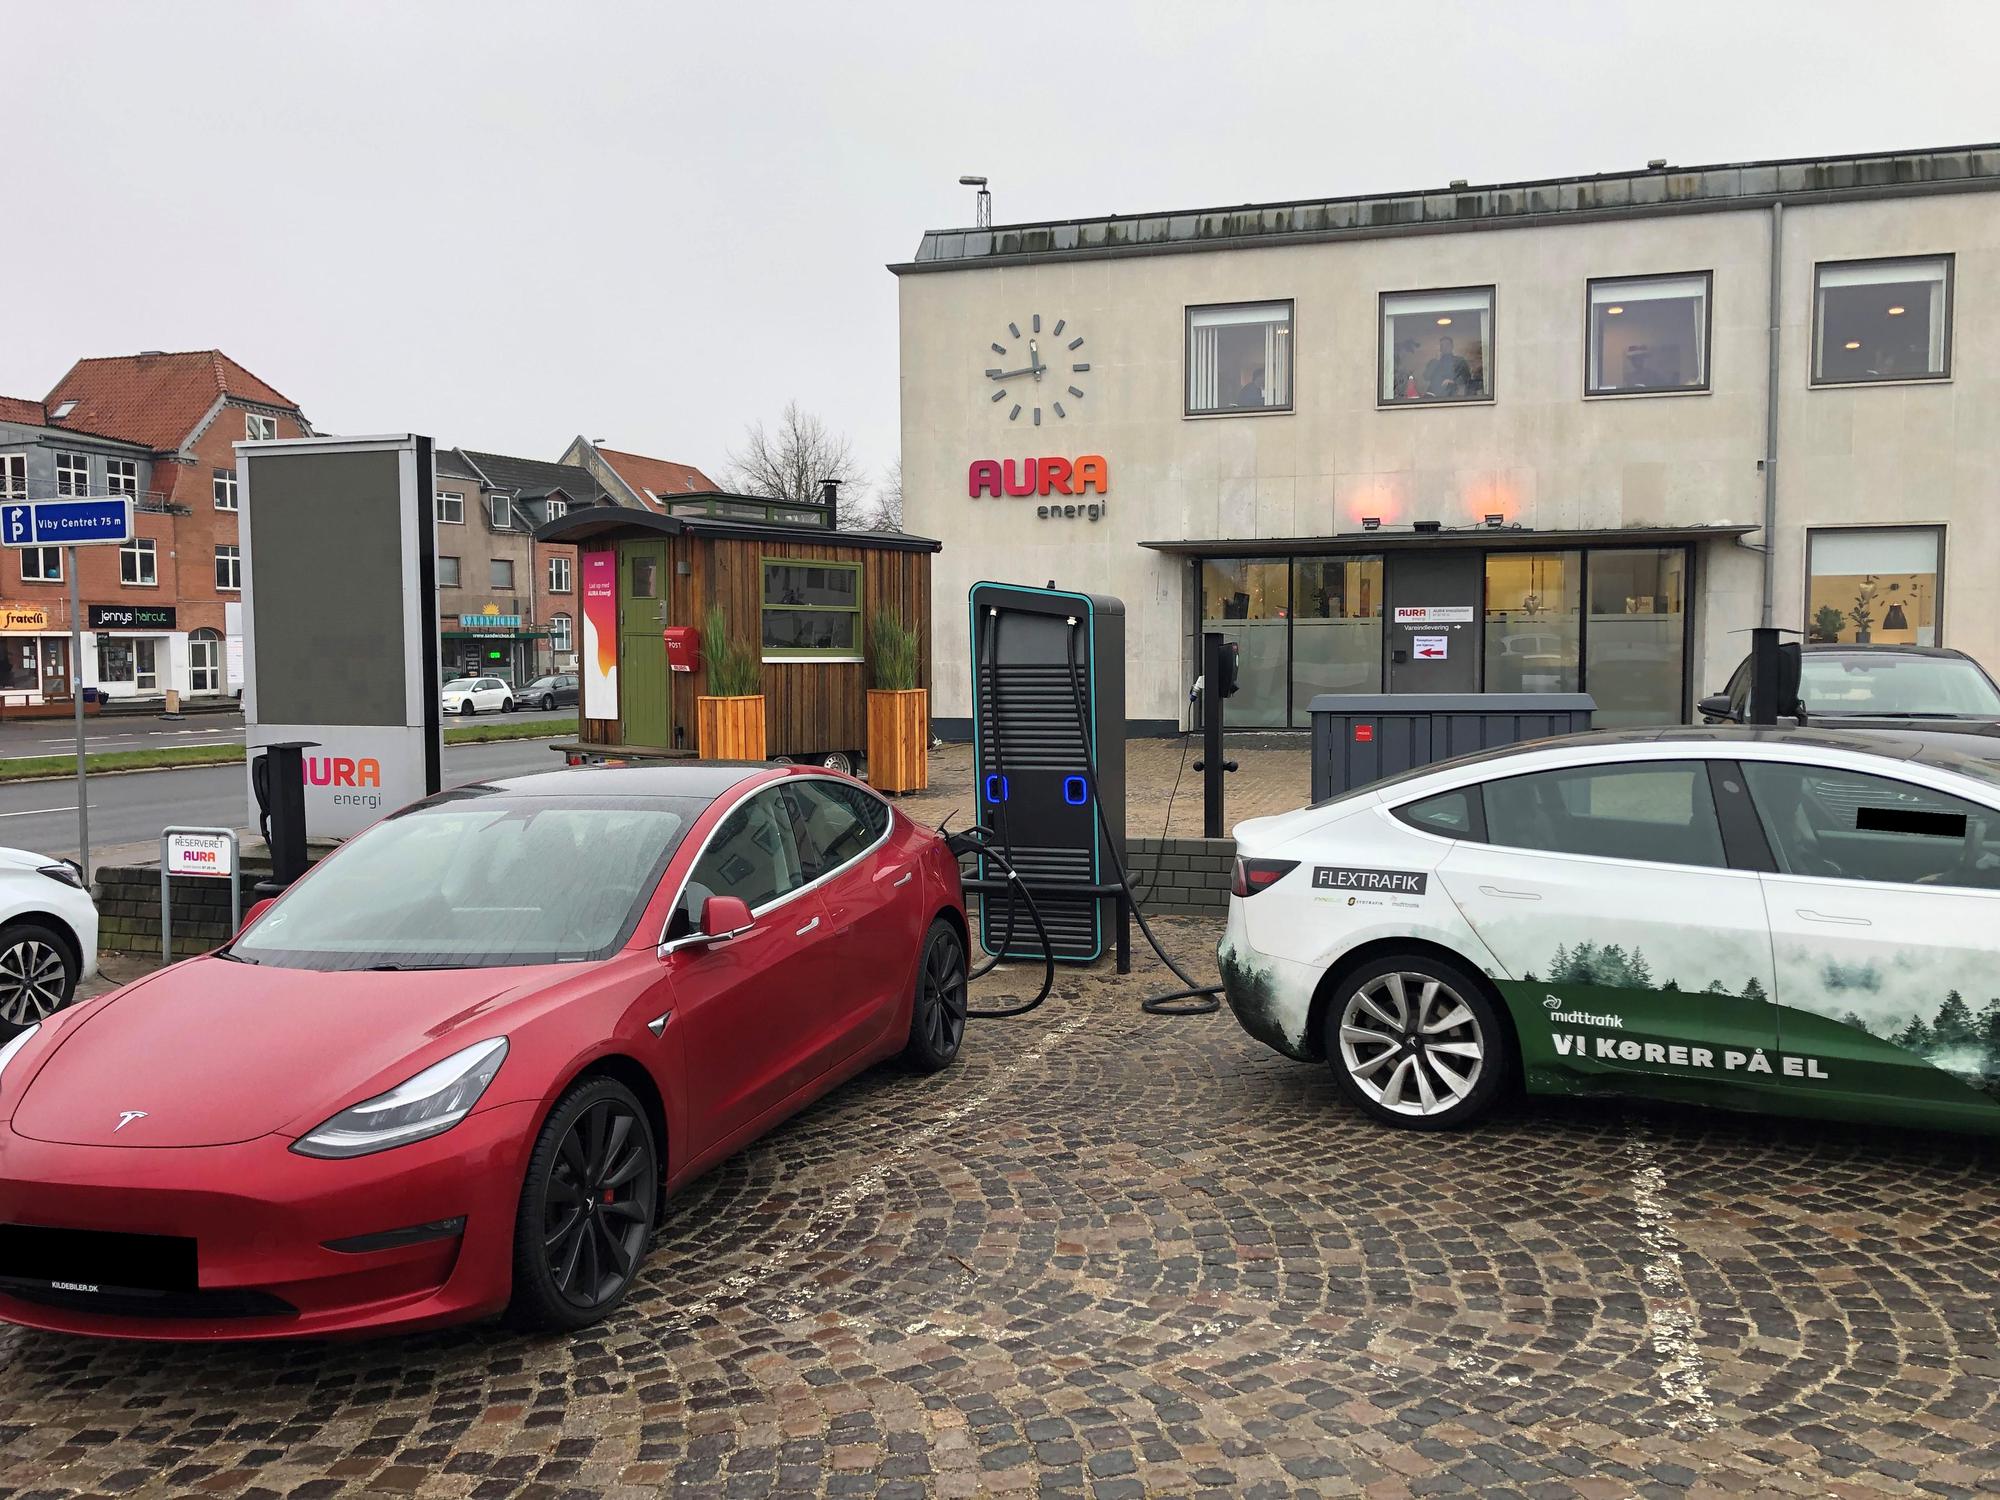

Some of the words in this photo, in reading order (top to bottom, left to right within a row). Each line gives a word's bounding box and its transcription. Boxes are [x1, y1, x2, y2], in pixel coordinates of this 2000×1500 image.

[969, 455, 1107, 498] AURA
[1037, 500, 1106, 521] energi
[12, 522, 24, 541] P
[38, 519, 58, 530] Viby
[61, 517, 98, 528] Centret
[100, 517, 111, 526] 75
[4, 611, 44, 629] fratelli
[98, 609, 133, 625] jennys
[135, 607, 167, 625] haircut
[1398, 608, 1426, 617] AURA
[1404, 624, 1450, 632] Vareindlevering
[668, 641, 682, 649] POST
[302, 757, 380, 788] URA
[334, 793, 382, 810] energi
[175, 838, 224, 849] RESERVERET
[184, 850, 216, 862] AURA
[1318, 870, 1420, 891] FLEXTRAFIK
[1551, 1009, 1623, 1029] midttrafik
[1551, 1033, 1586, 1057] VI
[1596, 1037, 1714, 1068] KØRER
[1724, 1047, 1773, 1074] PÅ
[1783, 1056, 1829, 1080] EL
[51, 1281, 99, 1292] KILDEBILER.DK
